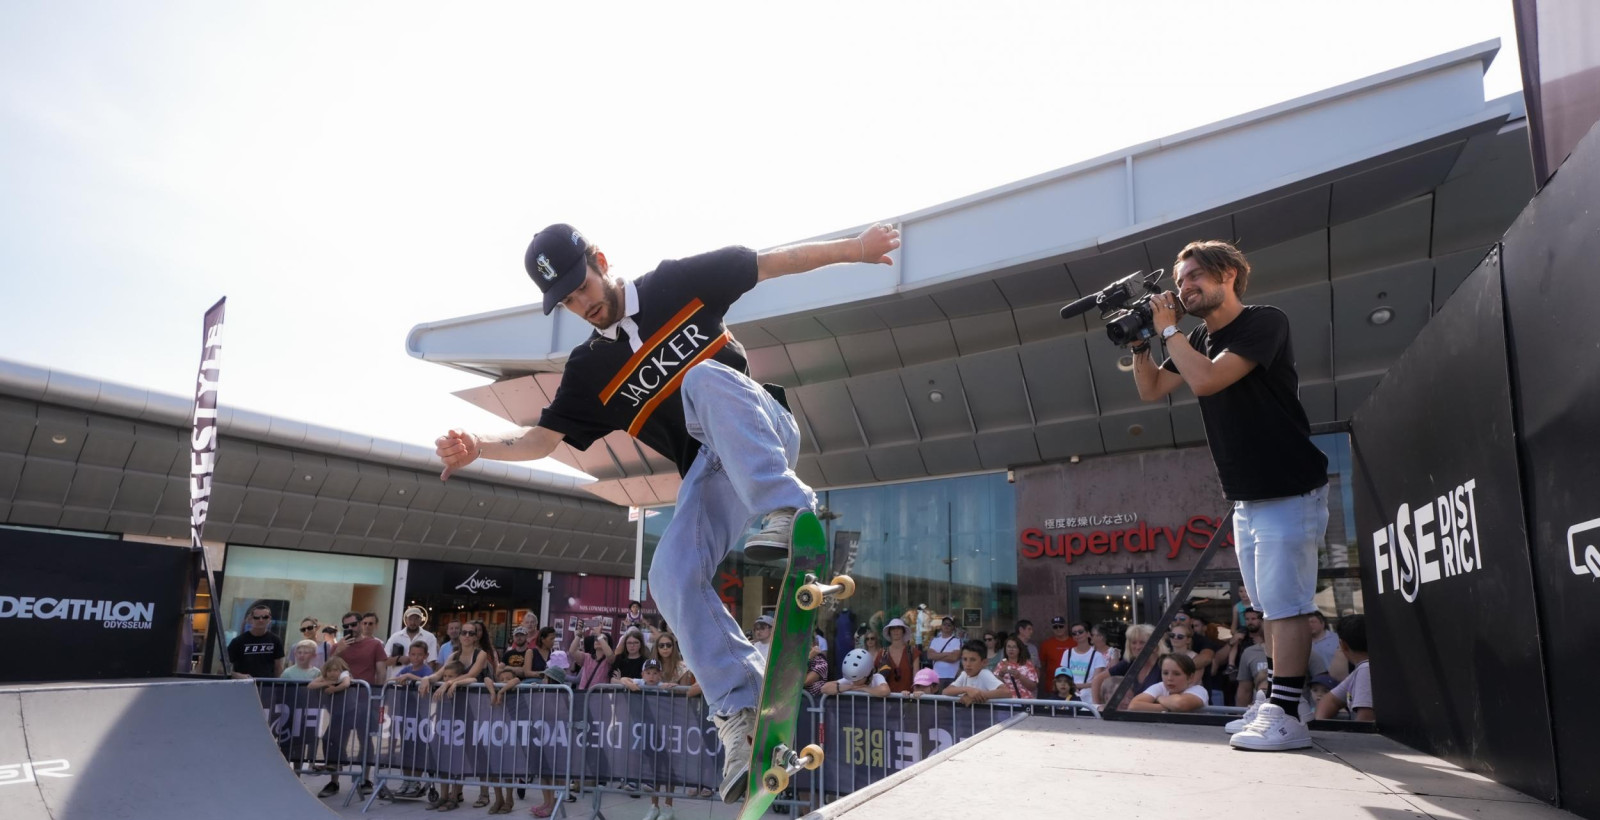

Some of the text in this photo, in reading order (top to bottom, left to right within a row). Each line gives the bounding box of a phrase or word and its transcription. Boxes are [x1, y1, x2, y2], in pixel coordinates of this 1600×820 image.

[620, 324, 709, 407] JACKER
[1044, 512, 1138, 529] 極度乾燥(しなさい)
[1020, 521, 1186, 564] Superdry
[1373, 502, 1440, 602] FISE
[455, 569, 502, 594] Lovisa
[0, 596, 155, 621] DECATHLON
[103, 620, 152, 629] ODYSSEUM
